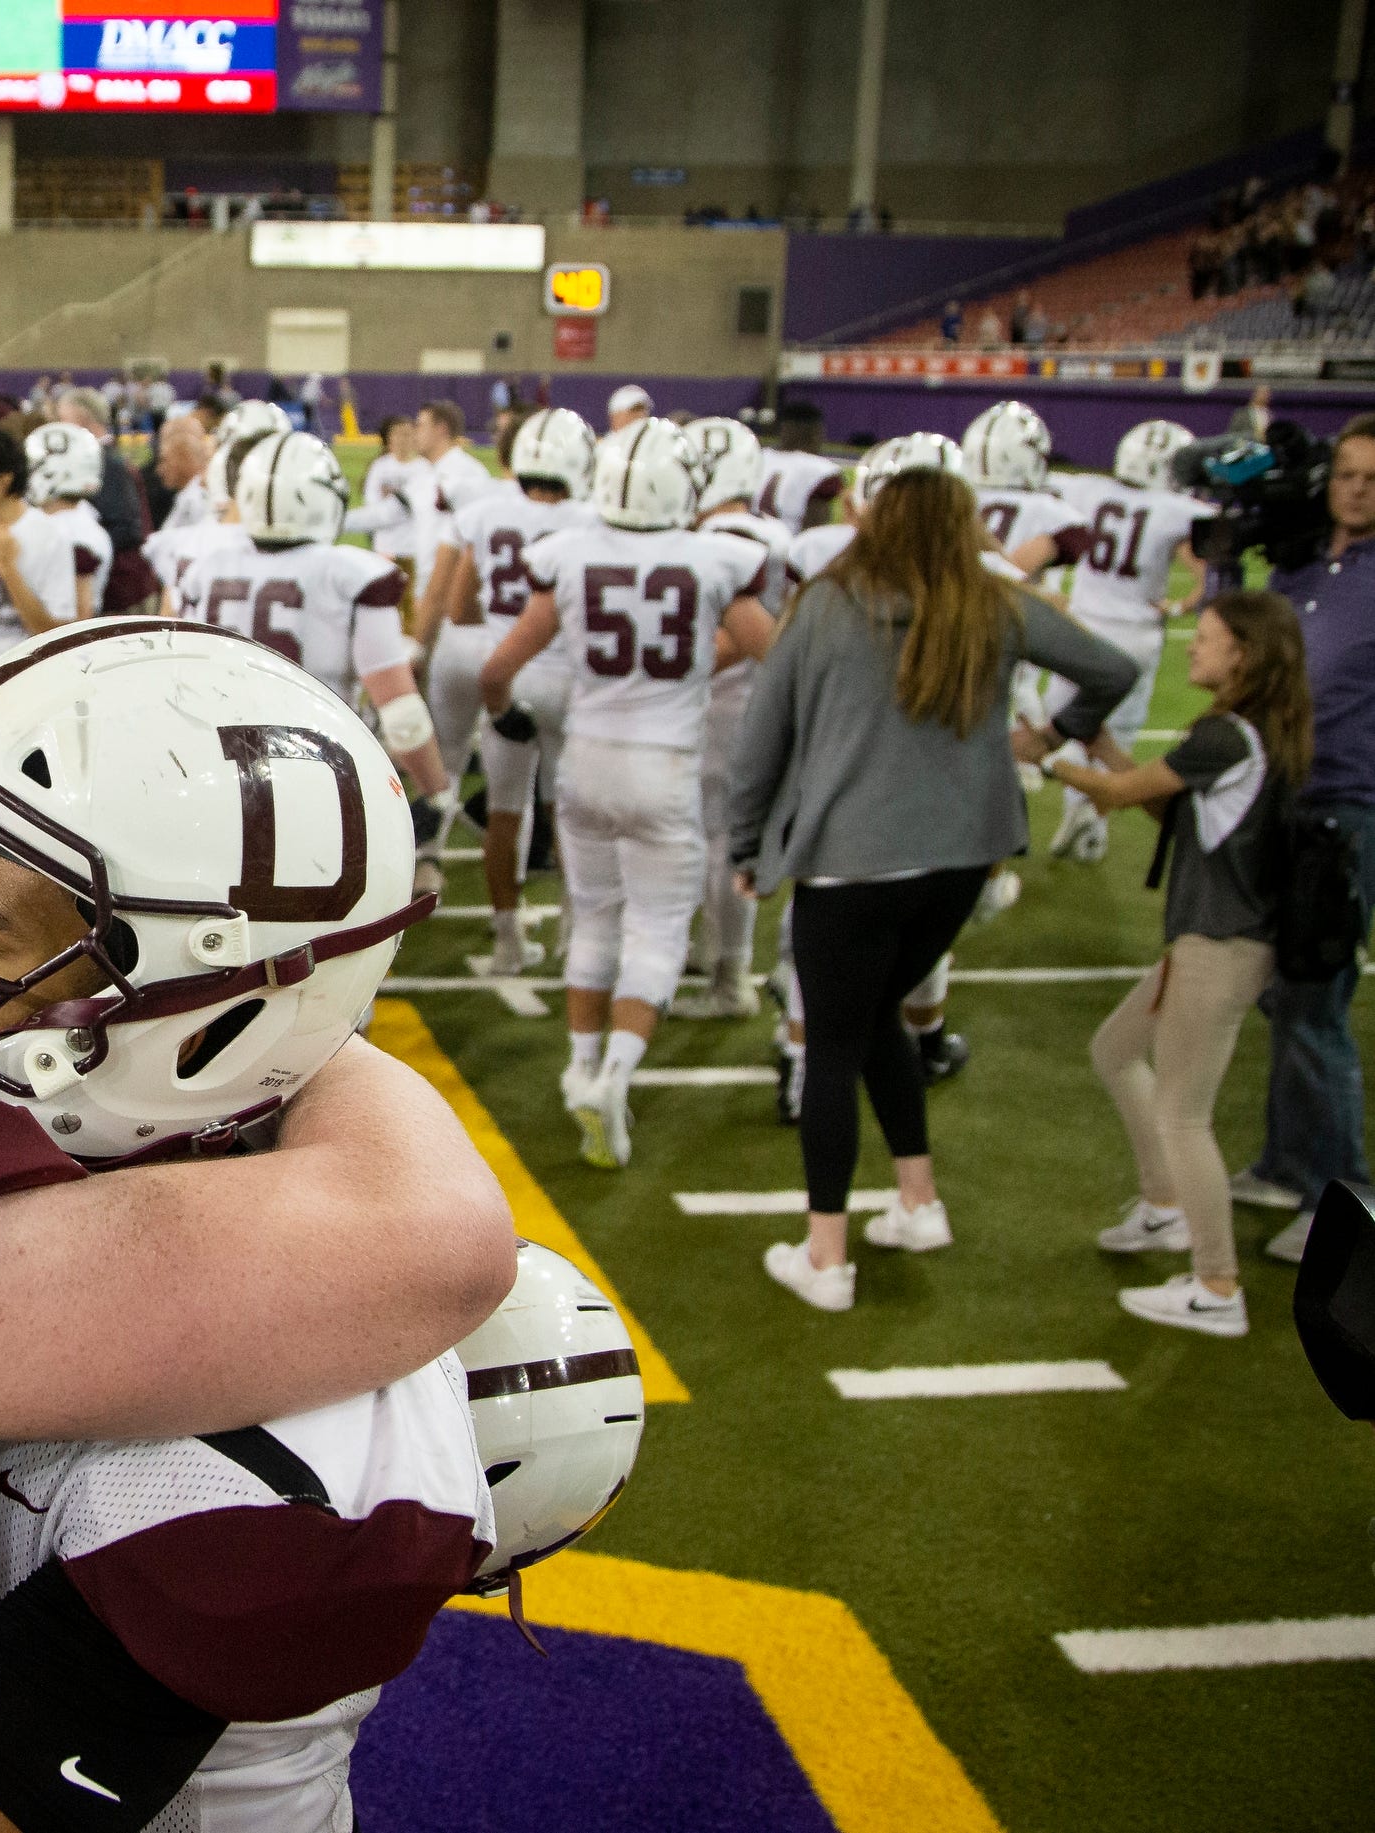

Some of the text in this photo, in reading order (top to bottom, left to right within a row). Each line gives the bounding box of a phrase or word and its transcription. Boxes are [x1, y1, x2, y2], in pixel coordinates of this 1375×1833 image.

[99, 19, 237, 62] DMACC
[1088, 501, 1152, 579] 61
[584, 564, 699, 680] 53
[217, 725, 368, 922] D
[258, 1076, 285, 1088] 2019
